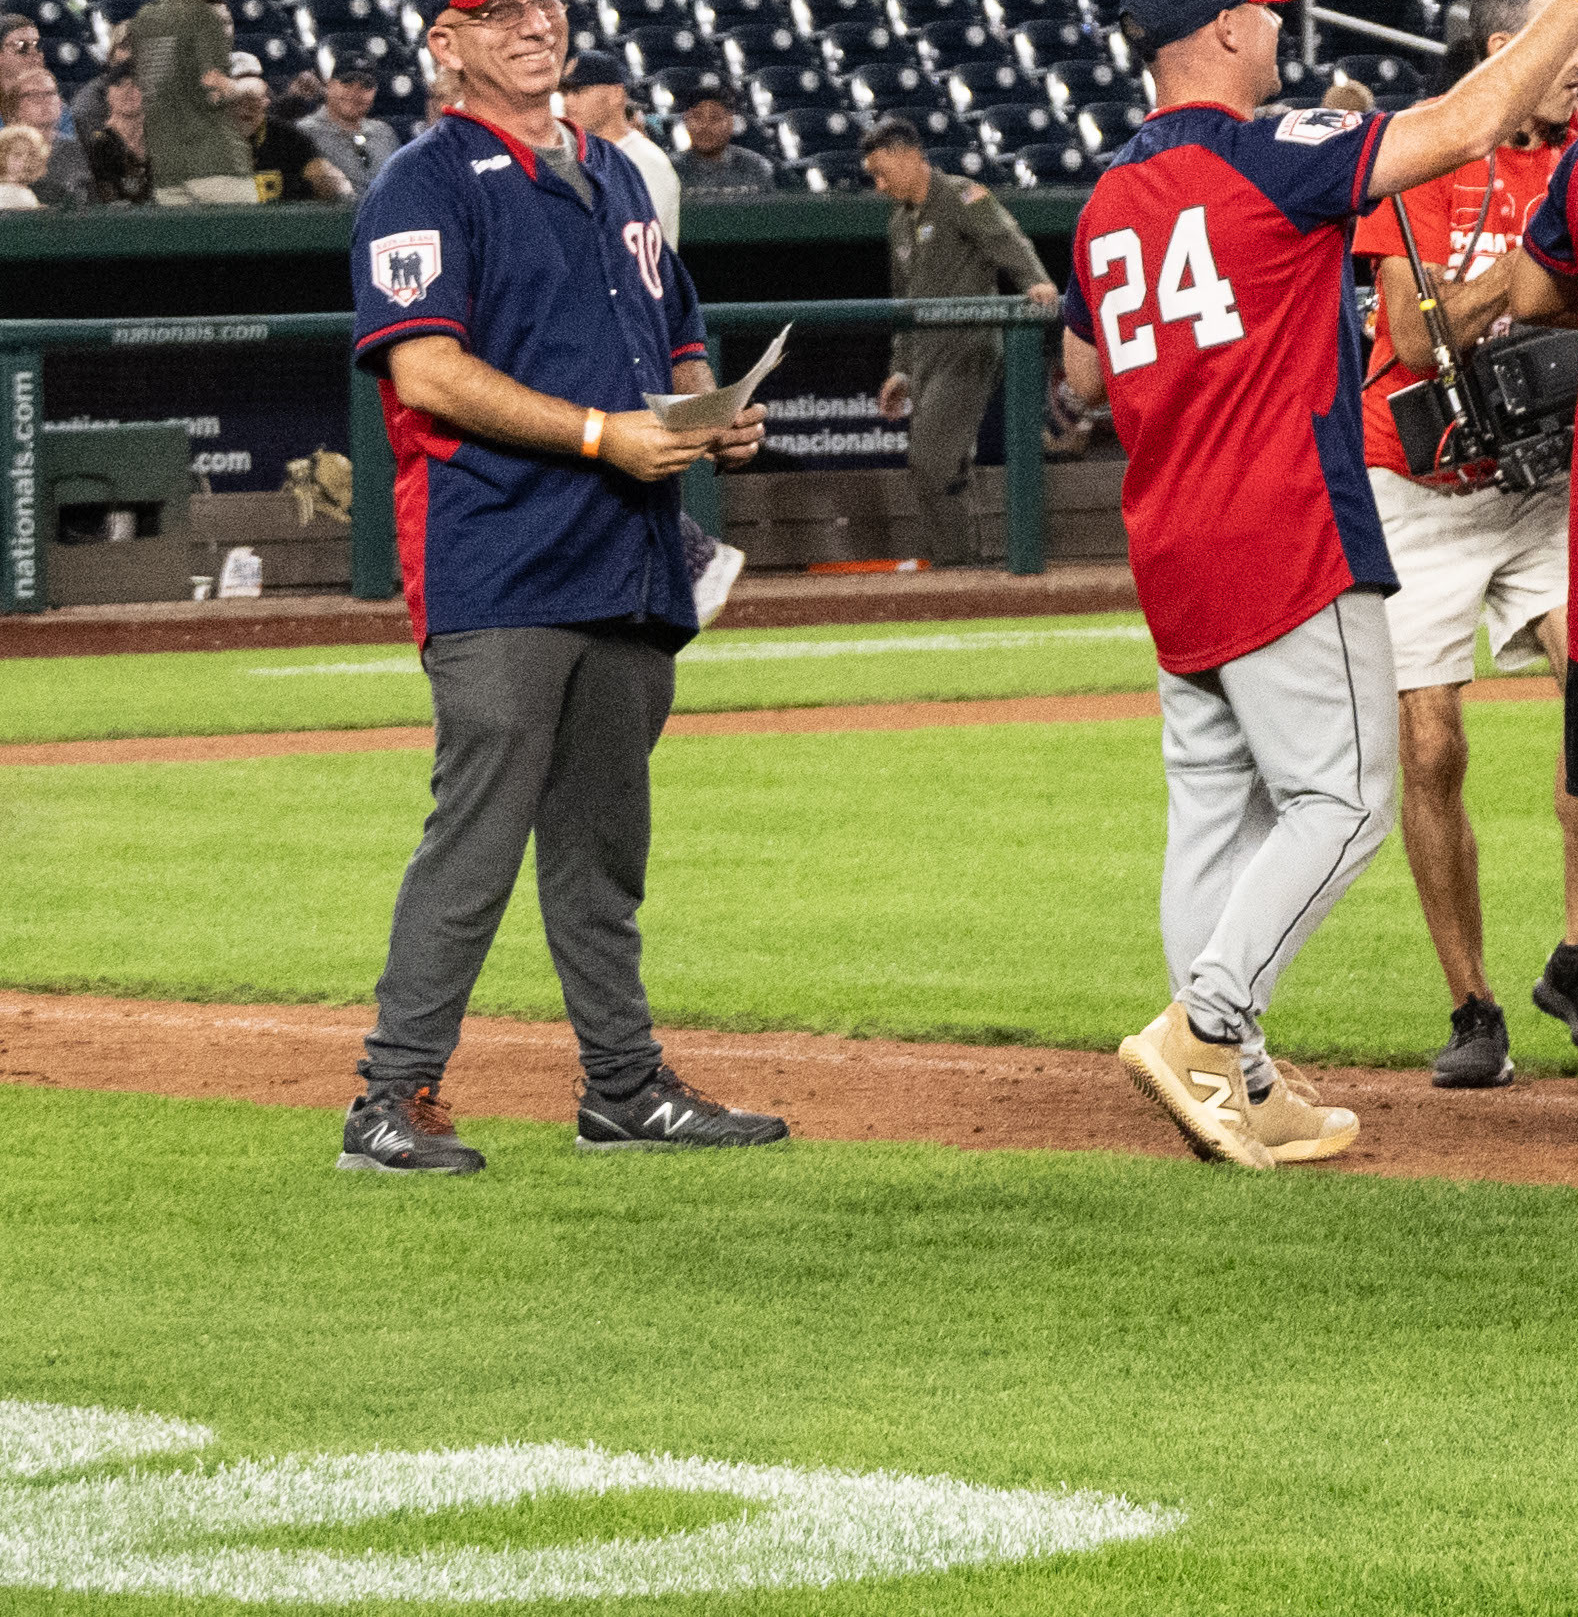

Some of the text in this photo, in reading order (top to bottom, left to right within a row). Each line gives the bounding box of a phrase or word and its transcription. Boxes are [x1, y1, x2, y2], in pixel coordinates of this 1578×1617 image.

[113, 323, 269, 344] nationals.com
[1089, 205, 1246, 376] 24
[14, 370, 36, 600] nationals.com
